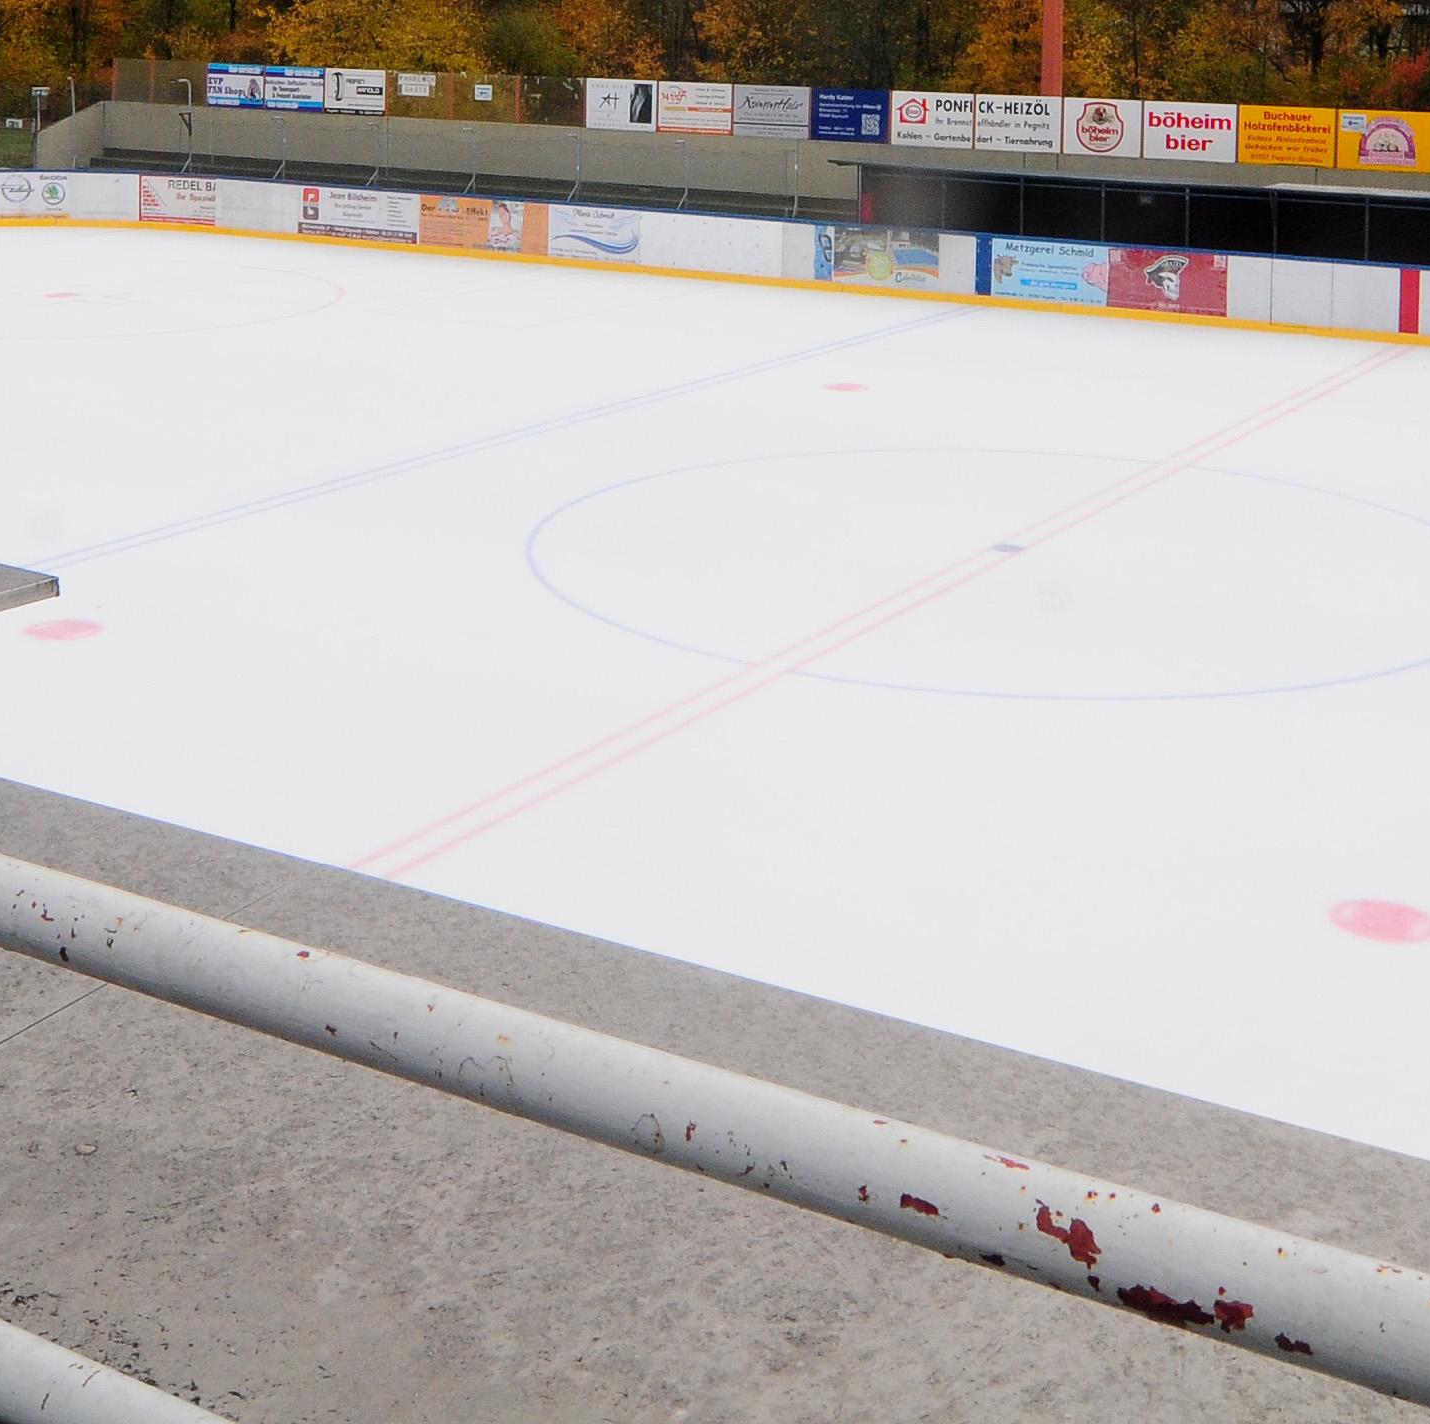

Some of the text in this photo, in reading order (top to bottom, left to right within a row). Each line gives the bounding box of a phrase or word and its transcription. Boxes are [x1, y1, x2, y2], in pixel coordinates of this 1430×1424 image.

[1148, 111, 1232, 130] böheim
[1263, 111, 1312, 122] Buchauer
[1081, 125, 1118, 136] böheim
[1244, 121, 1331, 134] Holzofenbäckerei
[897, 131, 922, 141] Kohlen
[1004, 134, 1053, 147] Tiernahrung
[1089, 134, 1110, 143] bier
[1165, 134, 1214, 151] bier
[1005, 242, 1094, 258] Metzgerei Schmid
